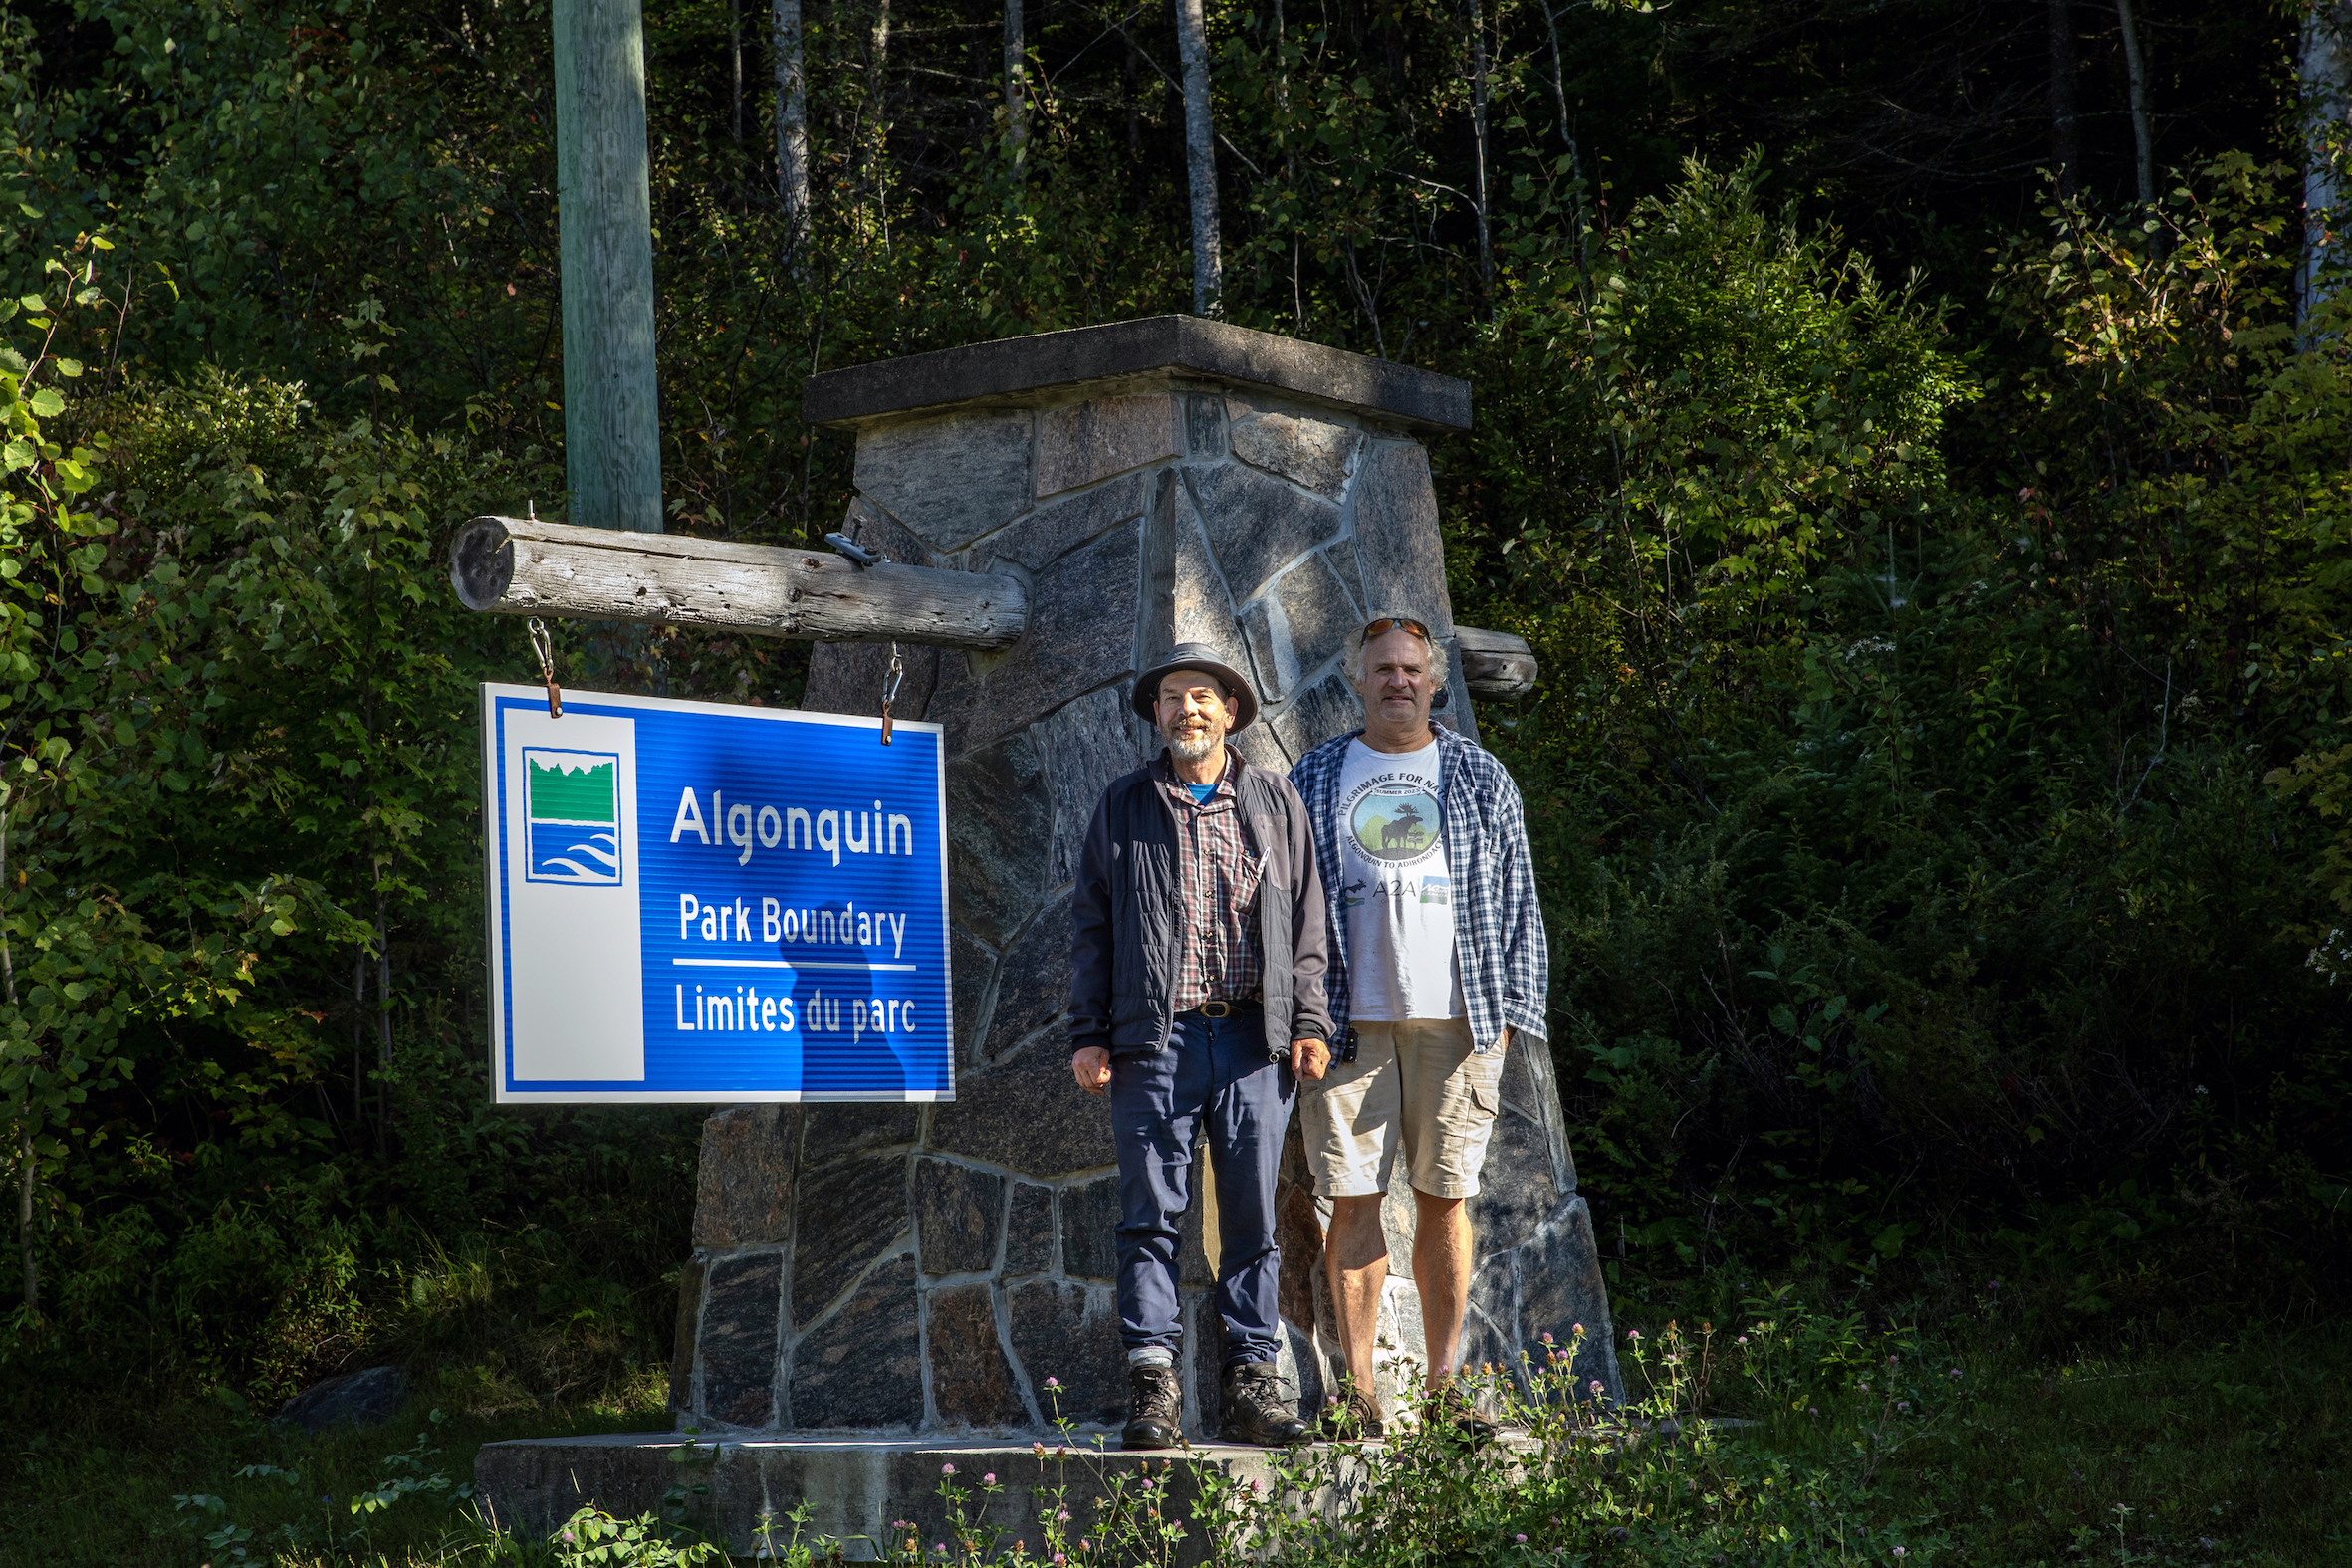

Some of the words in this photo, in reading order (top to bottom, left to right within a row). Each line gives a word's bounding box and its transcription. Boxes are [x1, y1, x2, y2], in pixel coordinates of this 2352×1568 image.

[1338, 773, 1394, 816] PILGRIMAGE
[1399, 773, 1423, 784] FOR
[1424, 780, 1446, 801] NATU
[669, 786, 913, 868] Algonquin
[1346, 835, 1381, 867] ALGONQUIN
[1397, 833, 1447, 868] ADIRONDACKS
[1372, 880, 1416, 898] A2A
[679, 893, 752, 942] Park
[762, 896, 906, 959] Boundary
[675, 984, 795, 1032] Limites
[806, 988, 841, 1032] du
[853, 997, 917, 1045] parc
